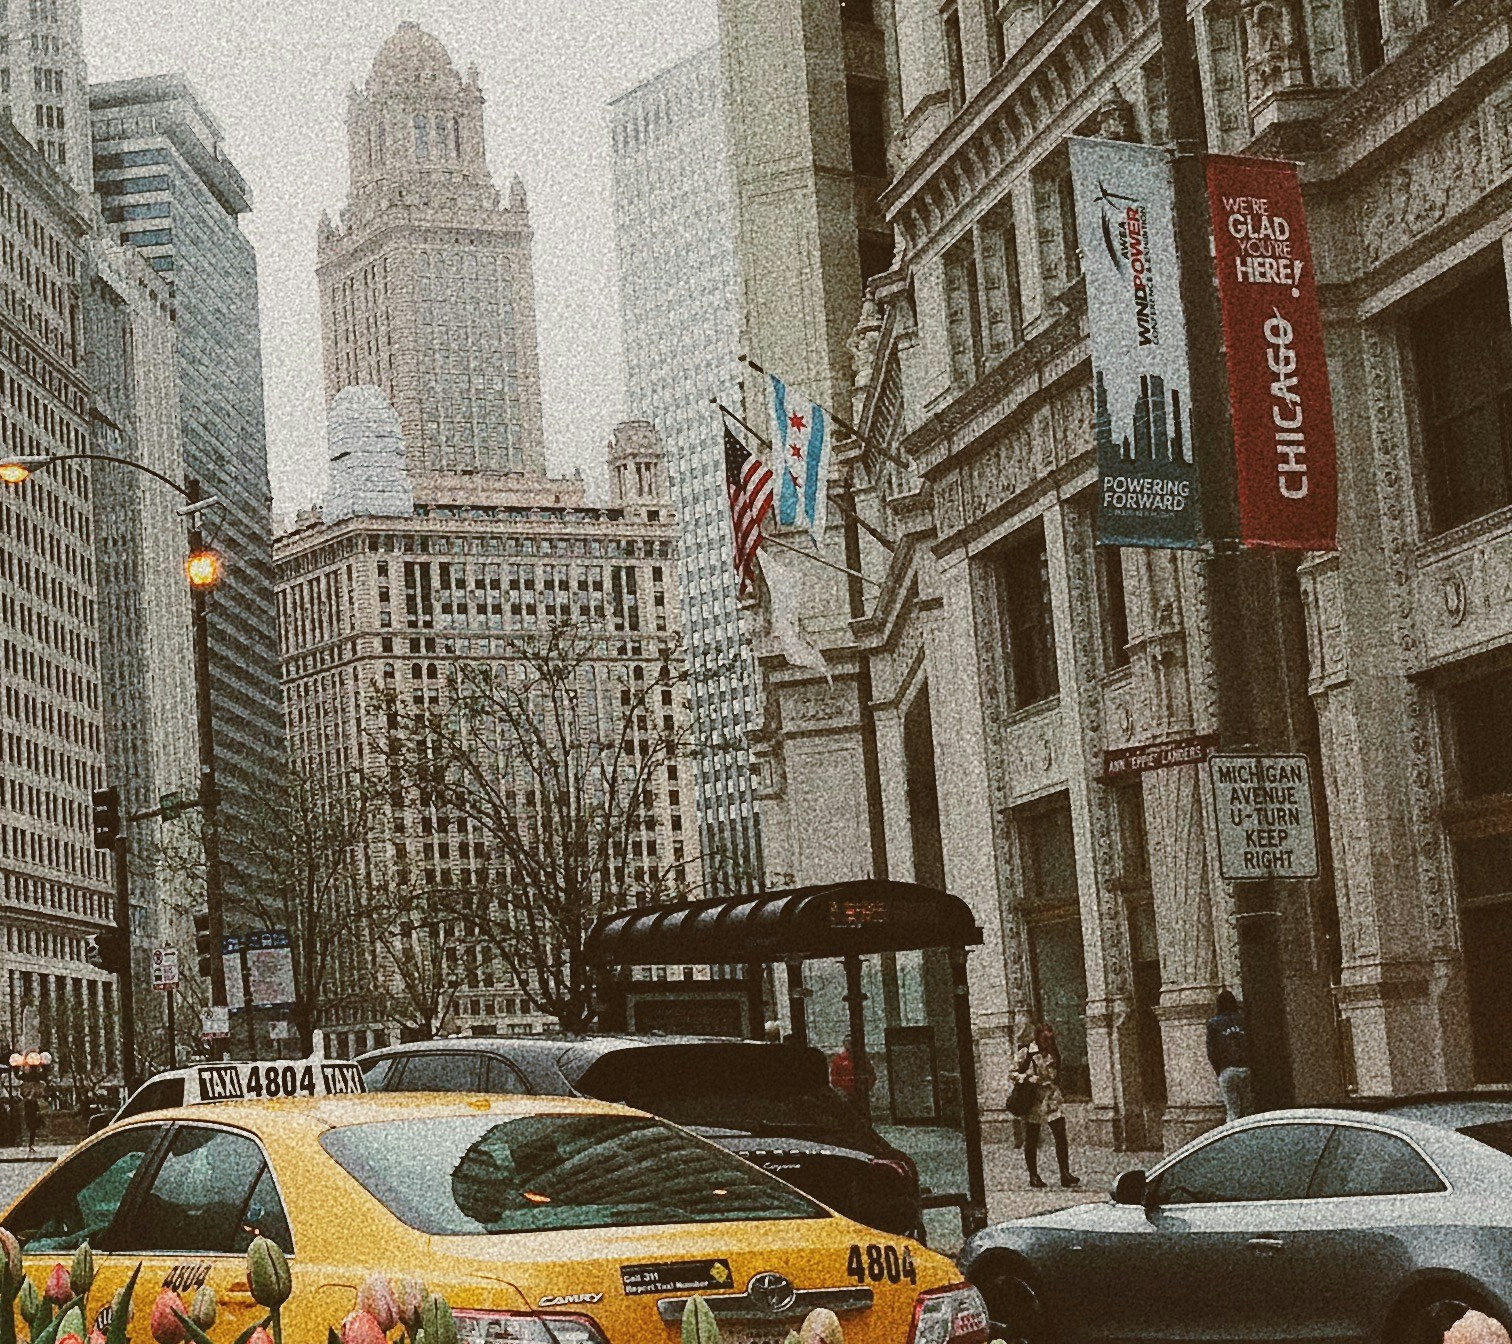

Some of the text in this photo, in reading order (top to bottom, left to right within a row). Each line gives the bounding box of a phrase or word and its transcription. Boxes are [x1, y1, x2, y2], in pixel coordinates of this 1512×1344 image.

[1222, 196, 1268, 216] WE'RE
[1228, 214, 1290, 241] GLAD
[1118, 221, 1130, 261] AWEA
[1237, 239, 1292, 258] YOU'RE
[1126, 206, 1152, 346] WINDPOWER
[1235, 256, 1305, 298] HERE!
[1146, 276, 1160, 346] CONFERENCE
[1263, 311, 1309, 500] CHICAGO
[1103, 477, 1190, 496] POWERING
[1103, 493, 1185, 511] FORWARD
[1218, 765, 1302, 784] MICHIGAN
[1230, 786, 1298, 805] AVENUE
[1230, 807, 1300, 826] U-TURN
[1245, 828, 1288, 848] KEEP
[1244, 850, 1294, 869] RIGHT
[201, 1065, 361, 1098] TAXI 4804 TAXI
[847, 1244, 917, 1285] 4804
[624, 1272, 658, 1283] Call 311
[625, 1284, 655, 1294] Report
[538, 1292, 604, 1307] CAMRY
